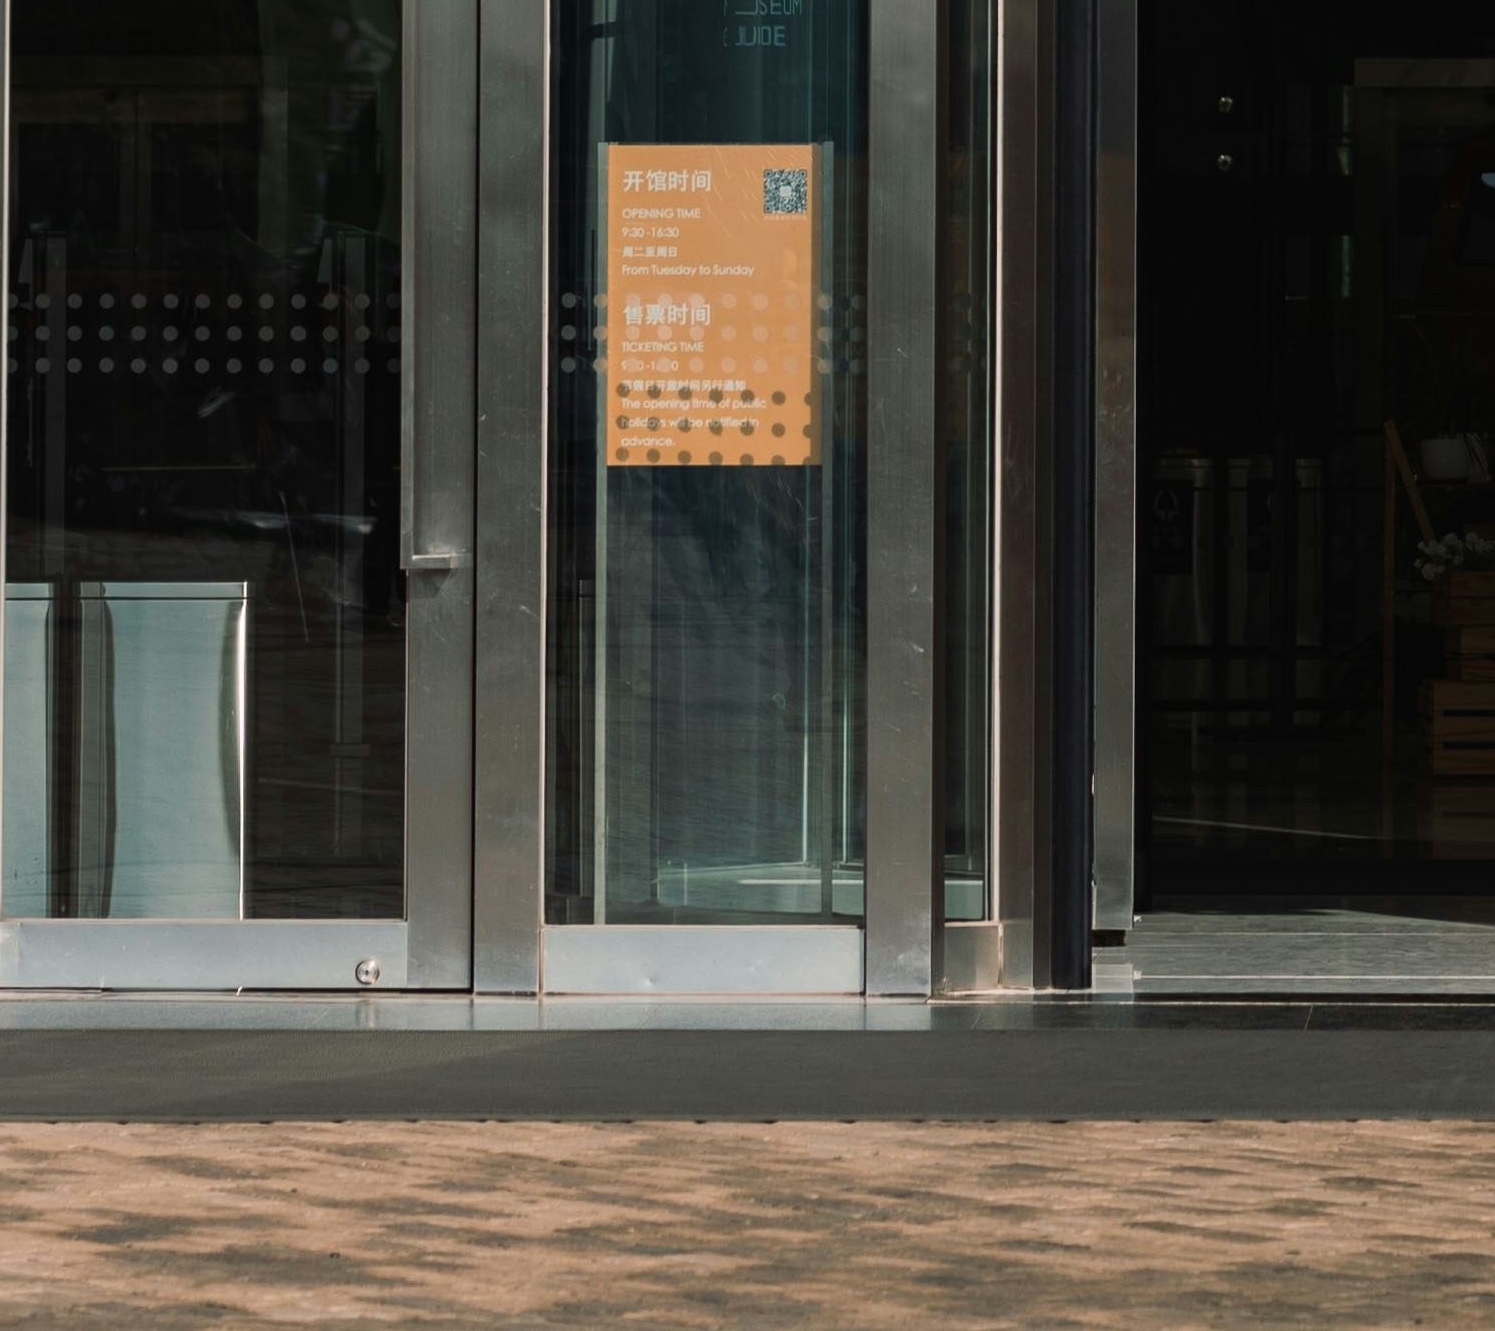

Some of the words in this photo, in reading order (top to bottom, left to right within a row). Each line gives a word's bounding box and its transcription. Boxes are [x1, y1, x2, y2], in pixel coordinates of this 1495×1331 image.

[623, 169, 711, 192] 开馆时间
[622, 208, 674, 219] OPENING
[676, 208, 701, 218] TIME
[622, 265, 649, 275] From
[651, 264, 697, 277] Tuesday
[699, 265, 711, 275] to
[713, 264, 755, 277] Sunday
[623, 303, 711, 326] 售票时间
[622, 341, 678, 352] TICKETING
[680, 341, 704, 352] TIME
[622, 399, 641, 409] The
[643, 399, 689, 411] opening
[719, 398, 731, 409] of
[621, 436, 675, 447] advance.
